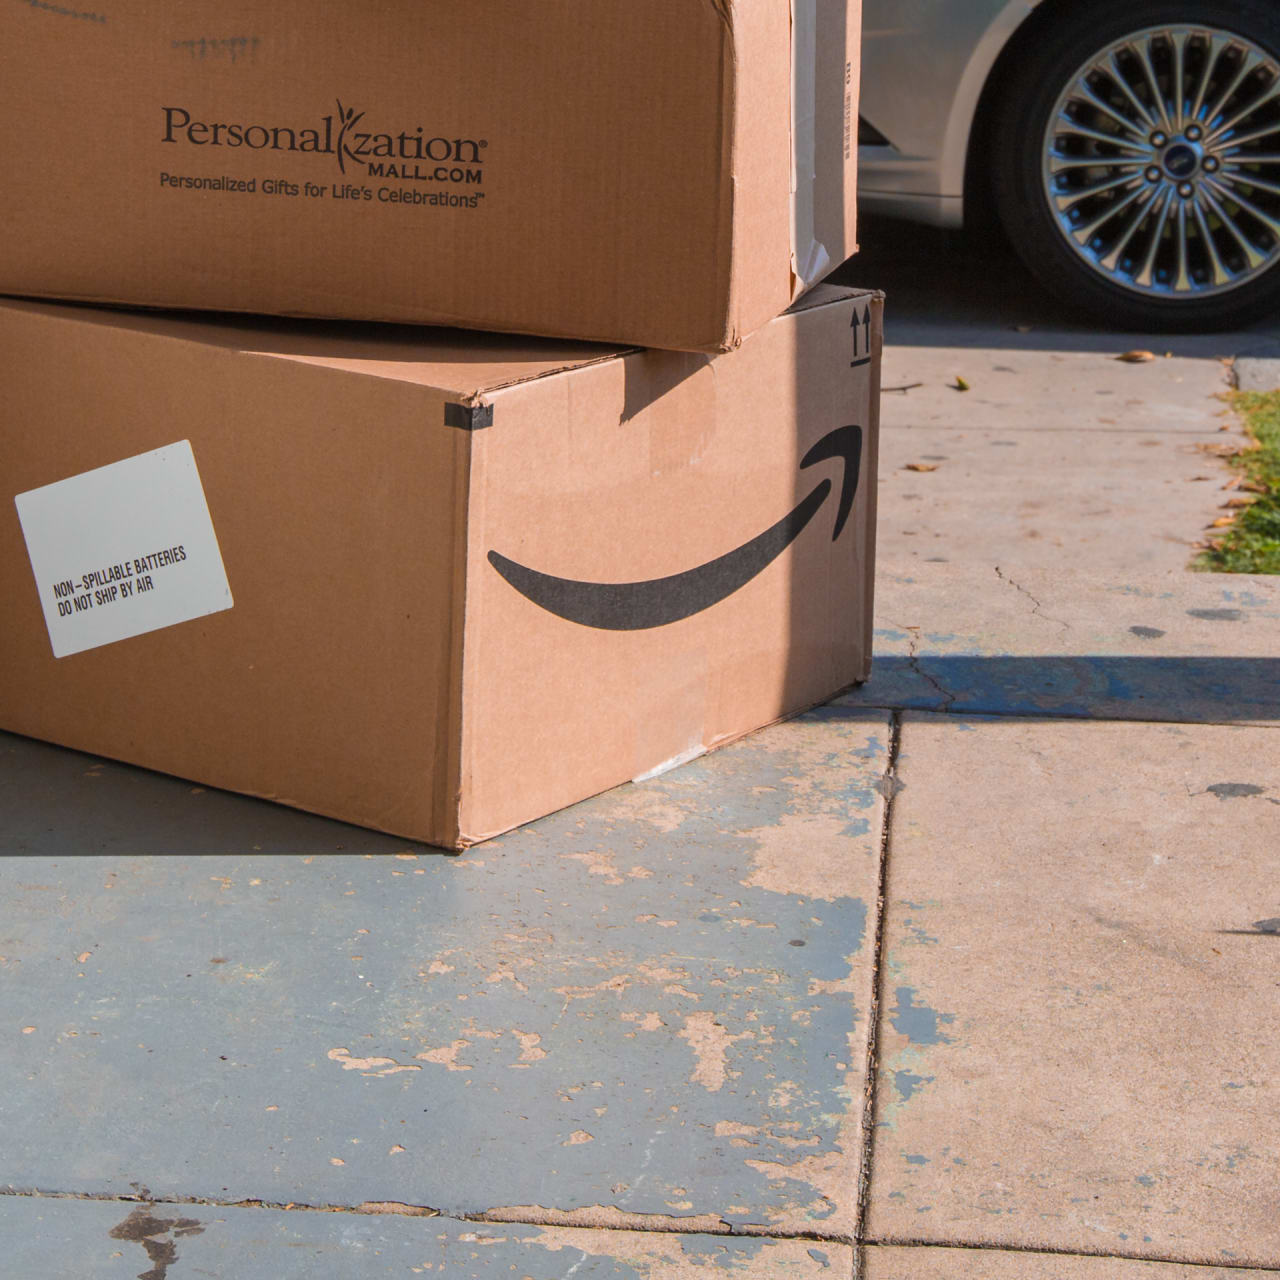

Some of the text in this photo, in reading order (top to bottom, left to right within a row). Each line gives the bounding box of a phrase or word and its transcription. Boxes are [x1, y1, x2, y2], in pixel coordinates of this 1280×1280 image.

[160, 173, 256, 193] Personalized
[261, 179, 299, 196] Gifts
[304, 182, 327, 198] for
[332, 184, 372, 201] Life's
[368, 162, 482, 184] MALL.COM
[133, 545, 187, 574] BATTERIES
[57, 575, 154, 617] DO NOT SHIP BY AIR
